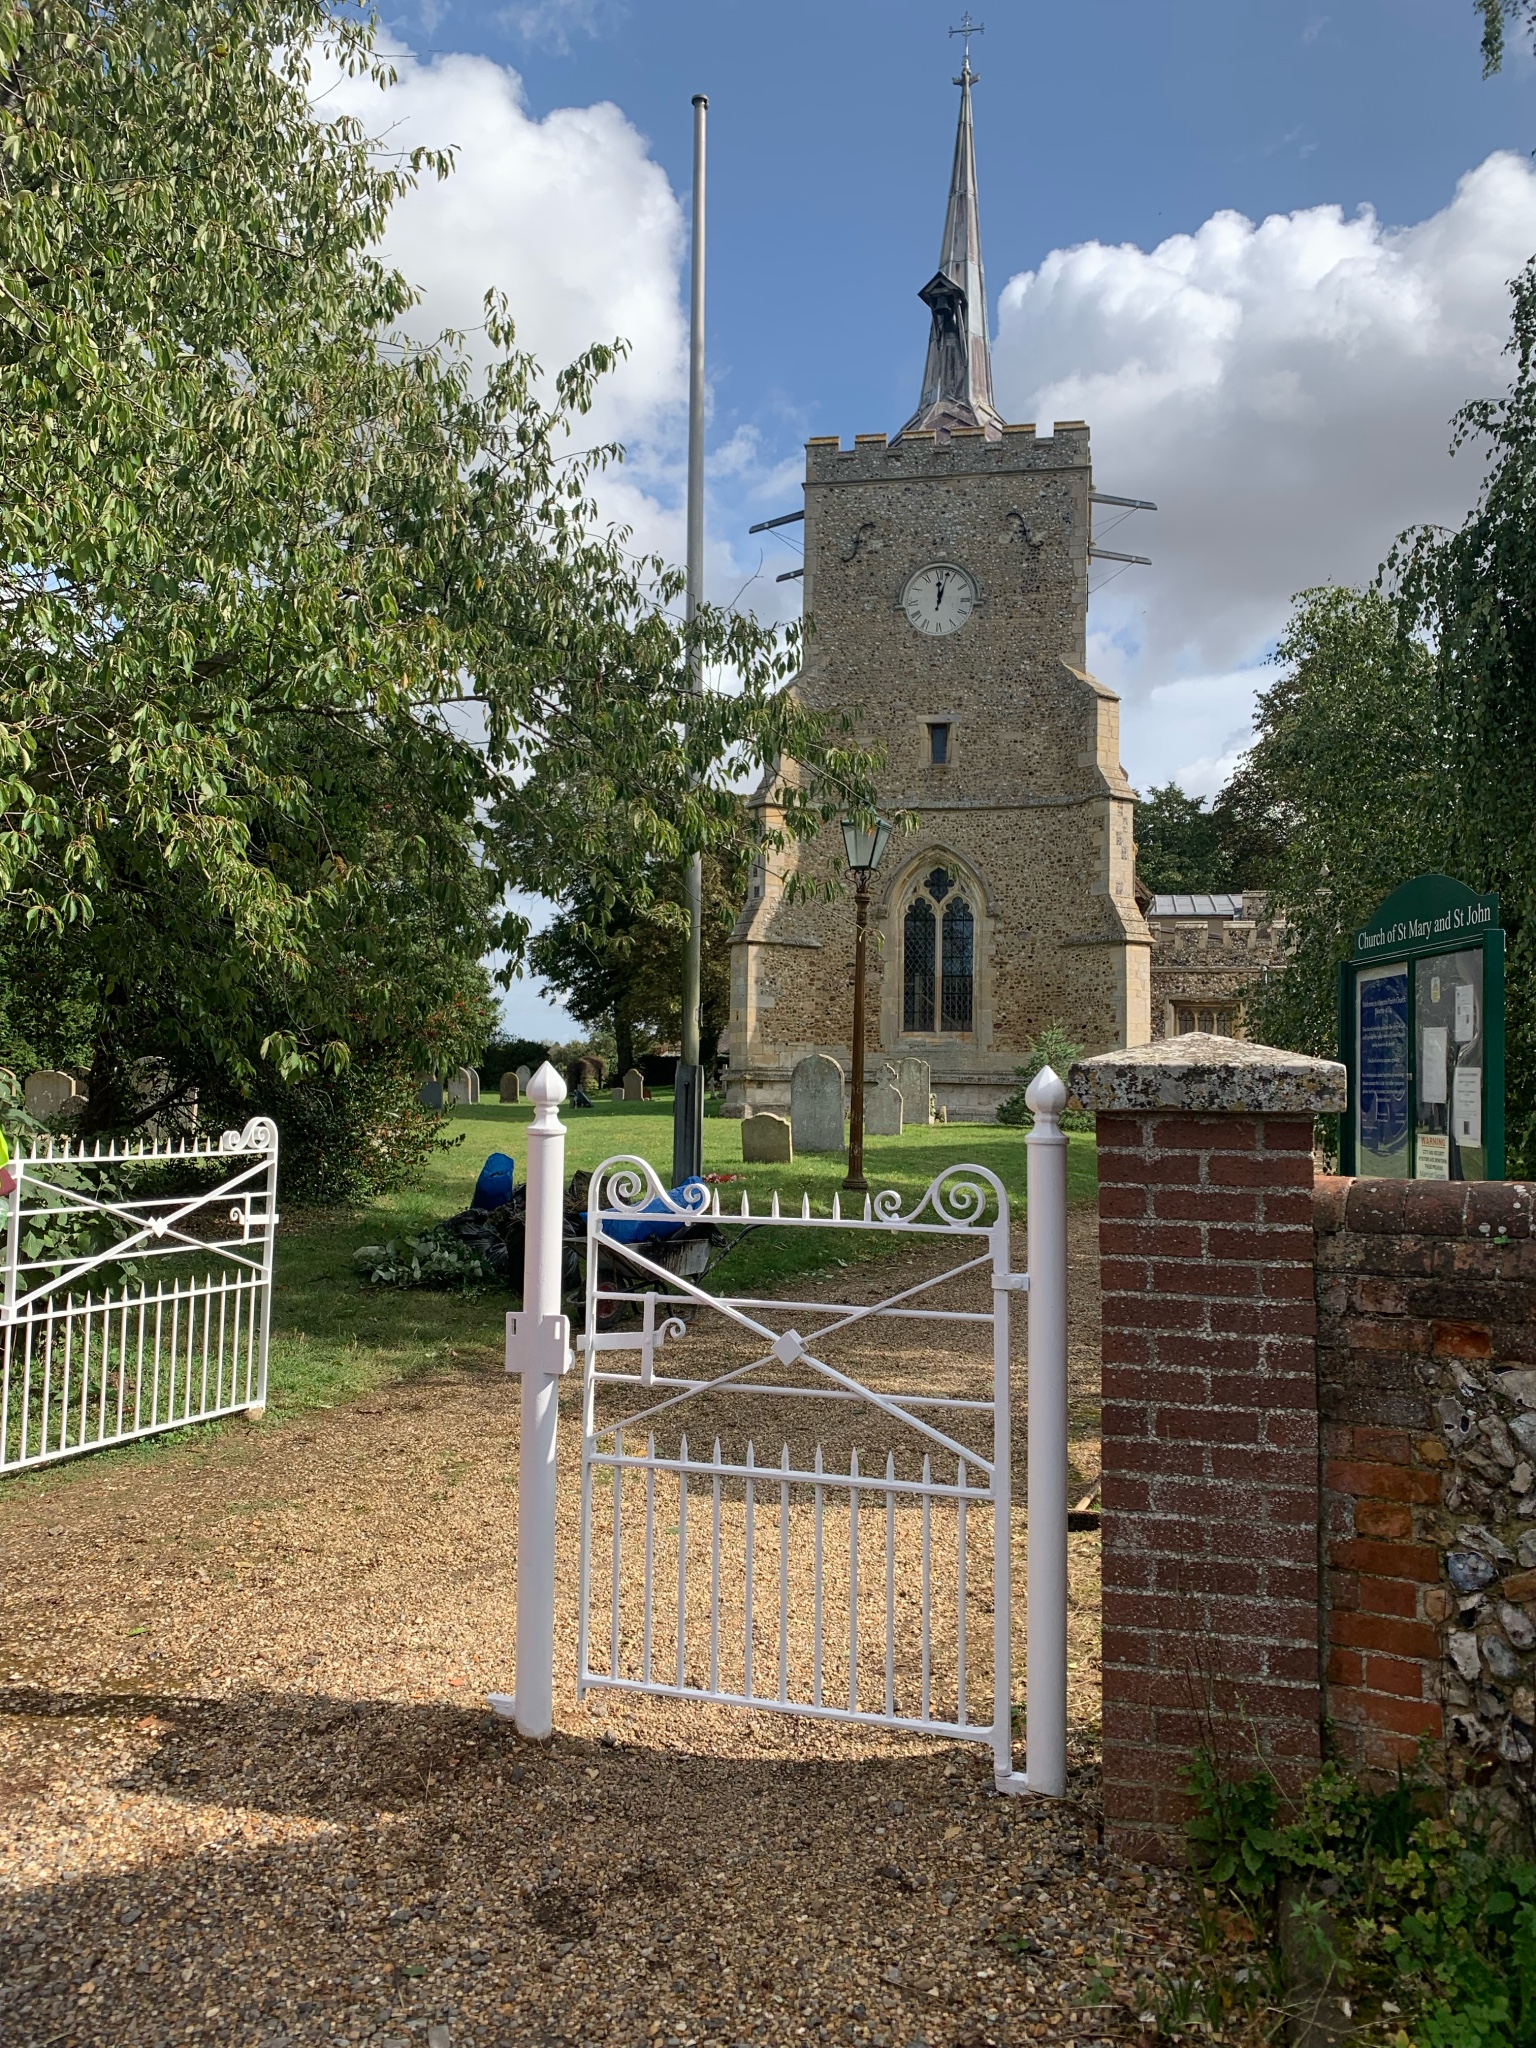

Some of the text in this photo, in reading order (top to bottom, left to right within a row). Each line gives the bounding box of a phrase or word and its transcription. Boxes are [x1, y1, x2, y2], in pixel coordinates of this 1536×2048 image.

[1358, 903, 1491, 950] Church of St Mary and St John
[1421, 1136, 1446, 1147] WARNING
